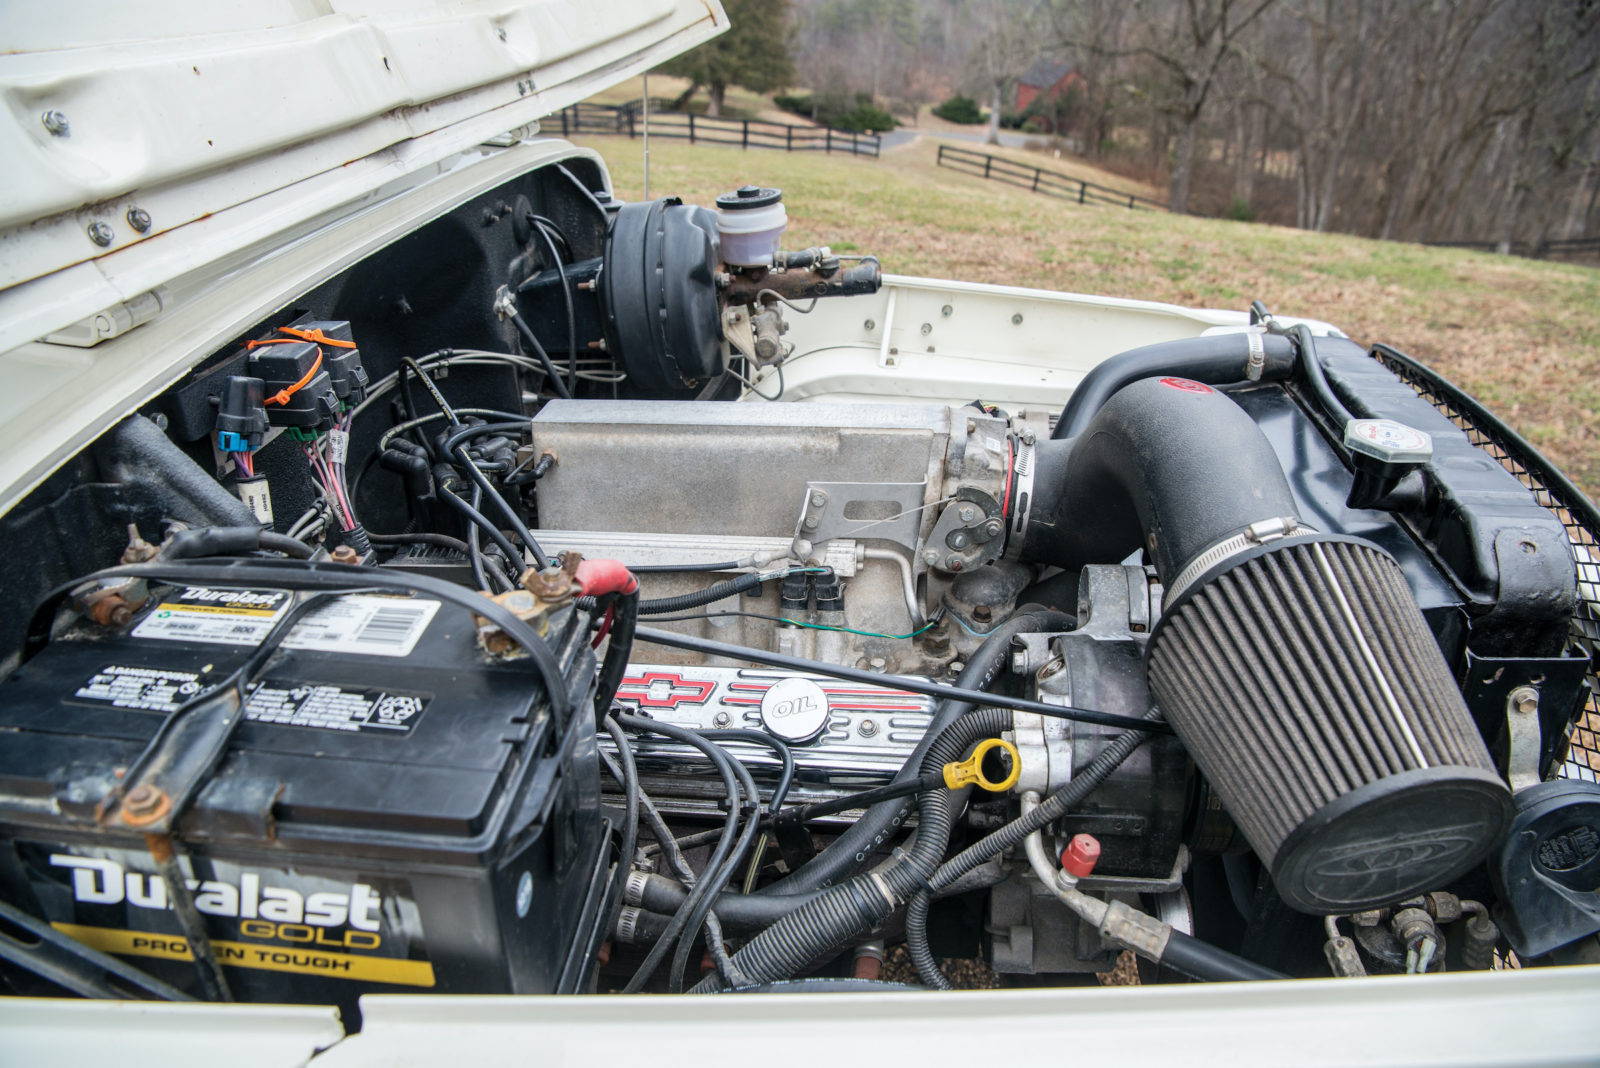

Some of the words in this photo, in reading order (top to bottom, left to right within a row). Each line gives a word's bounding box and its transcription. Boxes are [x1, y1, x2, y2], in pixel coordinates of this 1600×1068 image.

[181, 586, 284, 606] Duralast
[771, 695, 818, 719] OIL
[49, 853, 381, 932] Dualast
[240, 919, 382, 950] GOLD
[132, 937, 245, 960] PROEN
[254, 950, 352, 972] TOUGH
